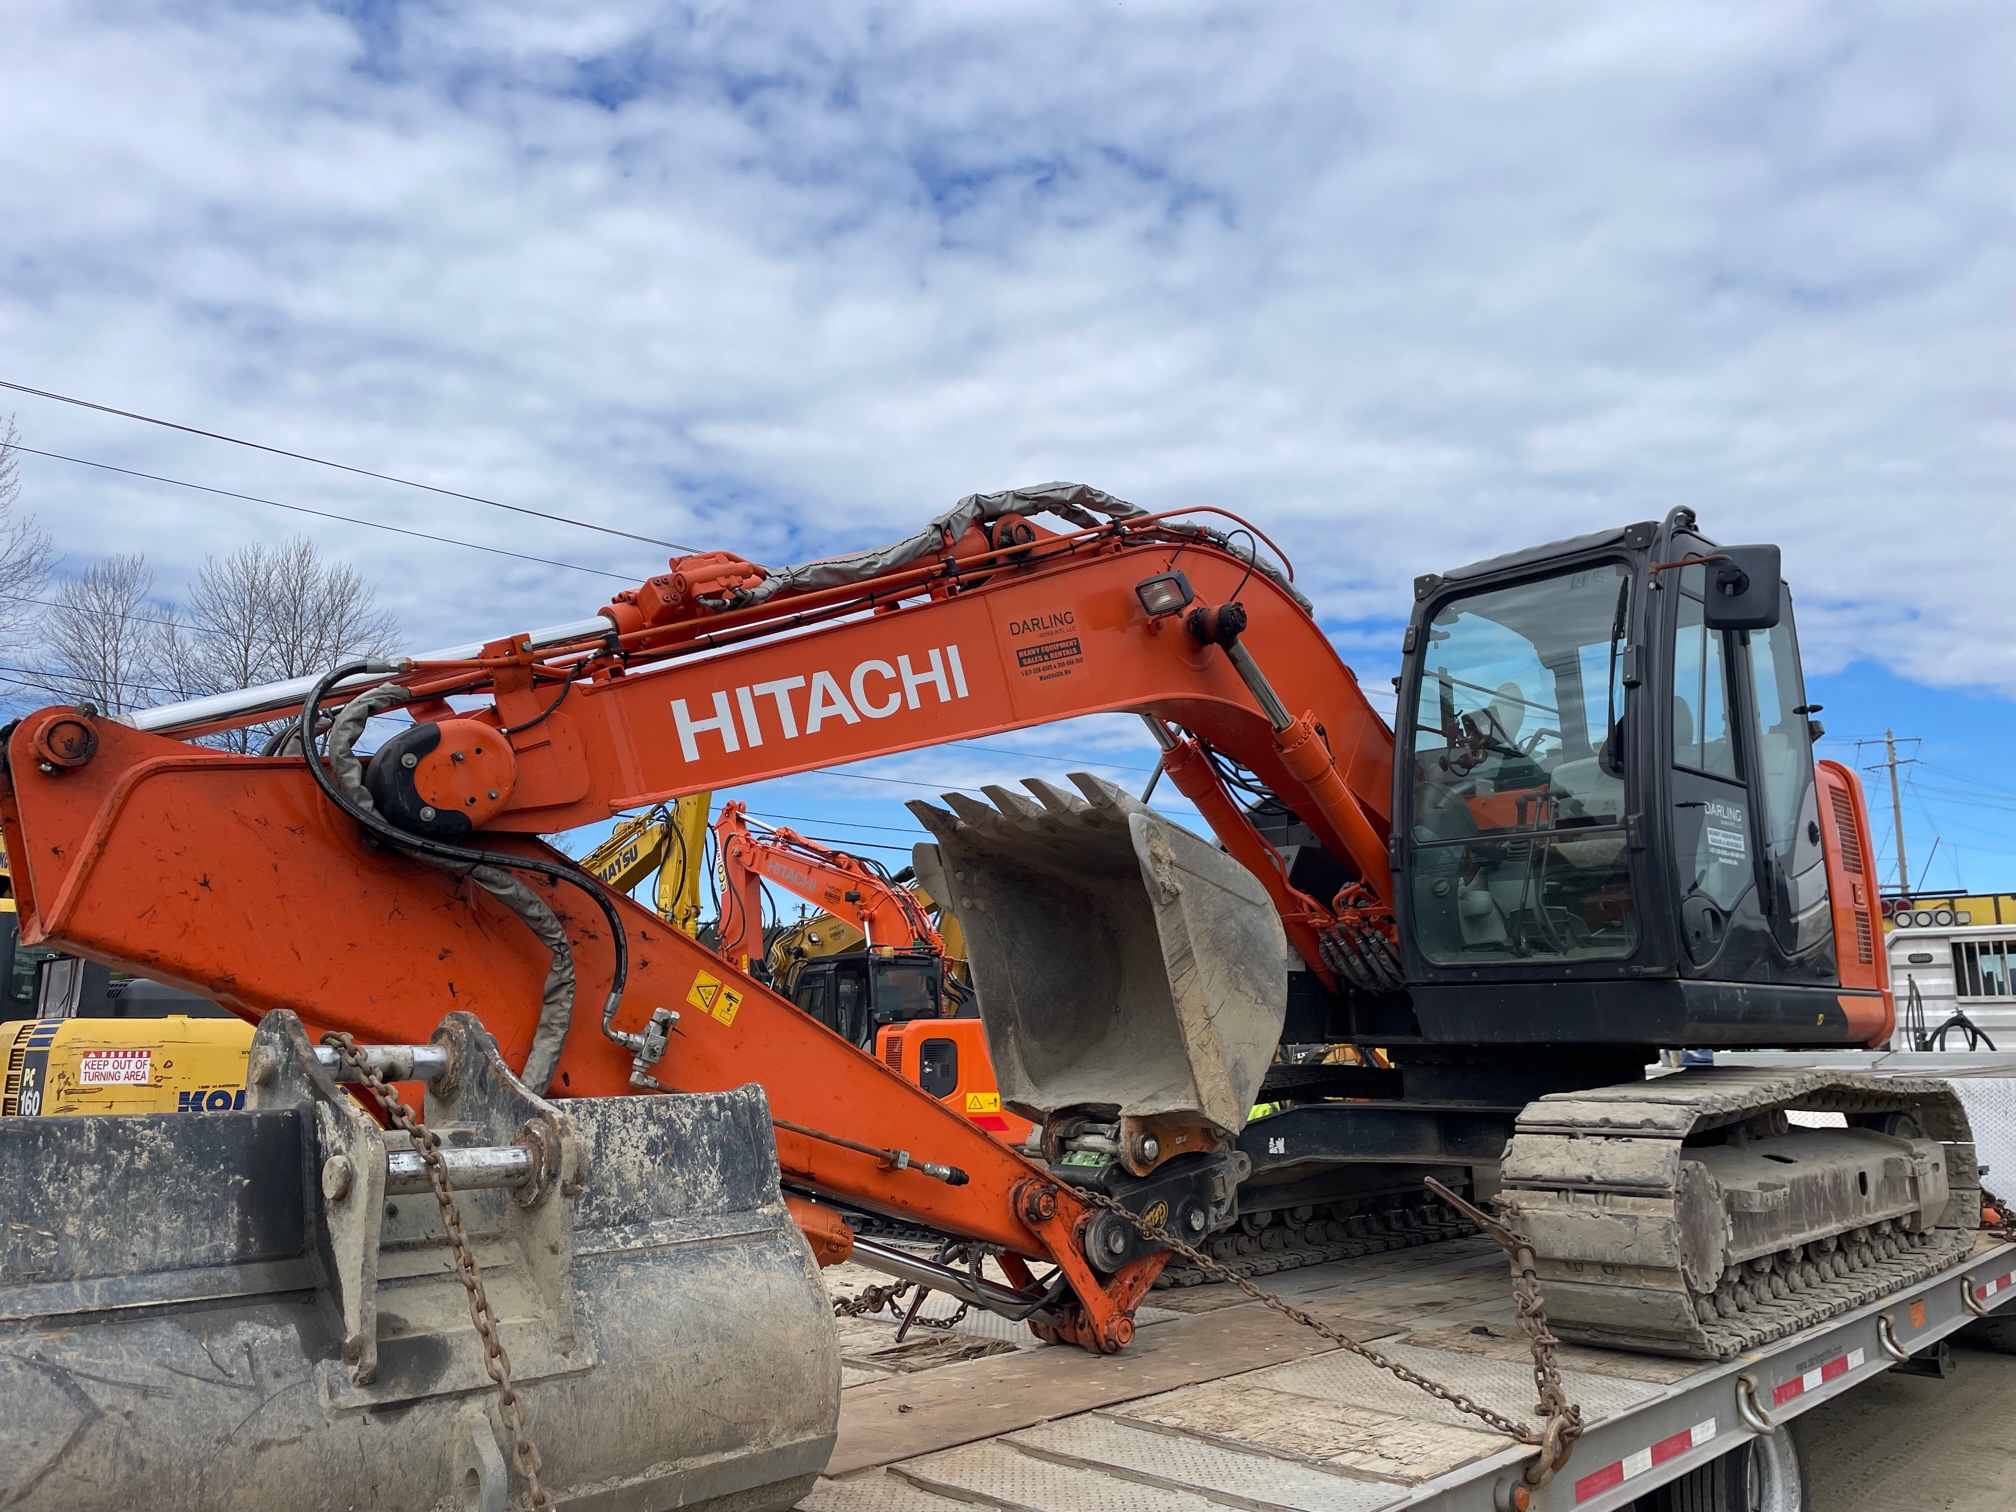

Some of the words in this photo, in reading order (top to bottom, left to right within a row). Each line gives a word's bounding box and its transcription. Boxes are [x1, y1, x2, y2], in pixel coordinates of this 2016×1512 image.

[1009, 611, 1074, 636] DARLING
[1018, 648, 1040, 658] HEAVY
[1041, 640, 1077, 653] EQUIPMENT
[1022, 656, 1043, 665] SALES
[1050, 648, 1077, 659] RENTALS
[670, 644, 969, 763] HITACHI
[1703, 801, 1742, 822] DARLING
[767, 860, 817, 893] HITACHI
[84, 1059, 110, 1071] KEEP
[112, 1059, 132, 1070] OUT
[135, 1059, 148, 1070] OF
[22, 1067, 36, 1087] PC
[83, 1071, 121, 1082] TURNING
[123, 1071, 147, 1081] AREA
[20, 1090, 40, 1116] 160
